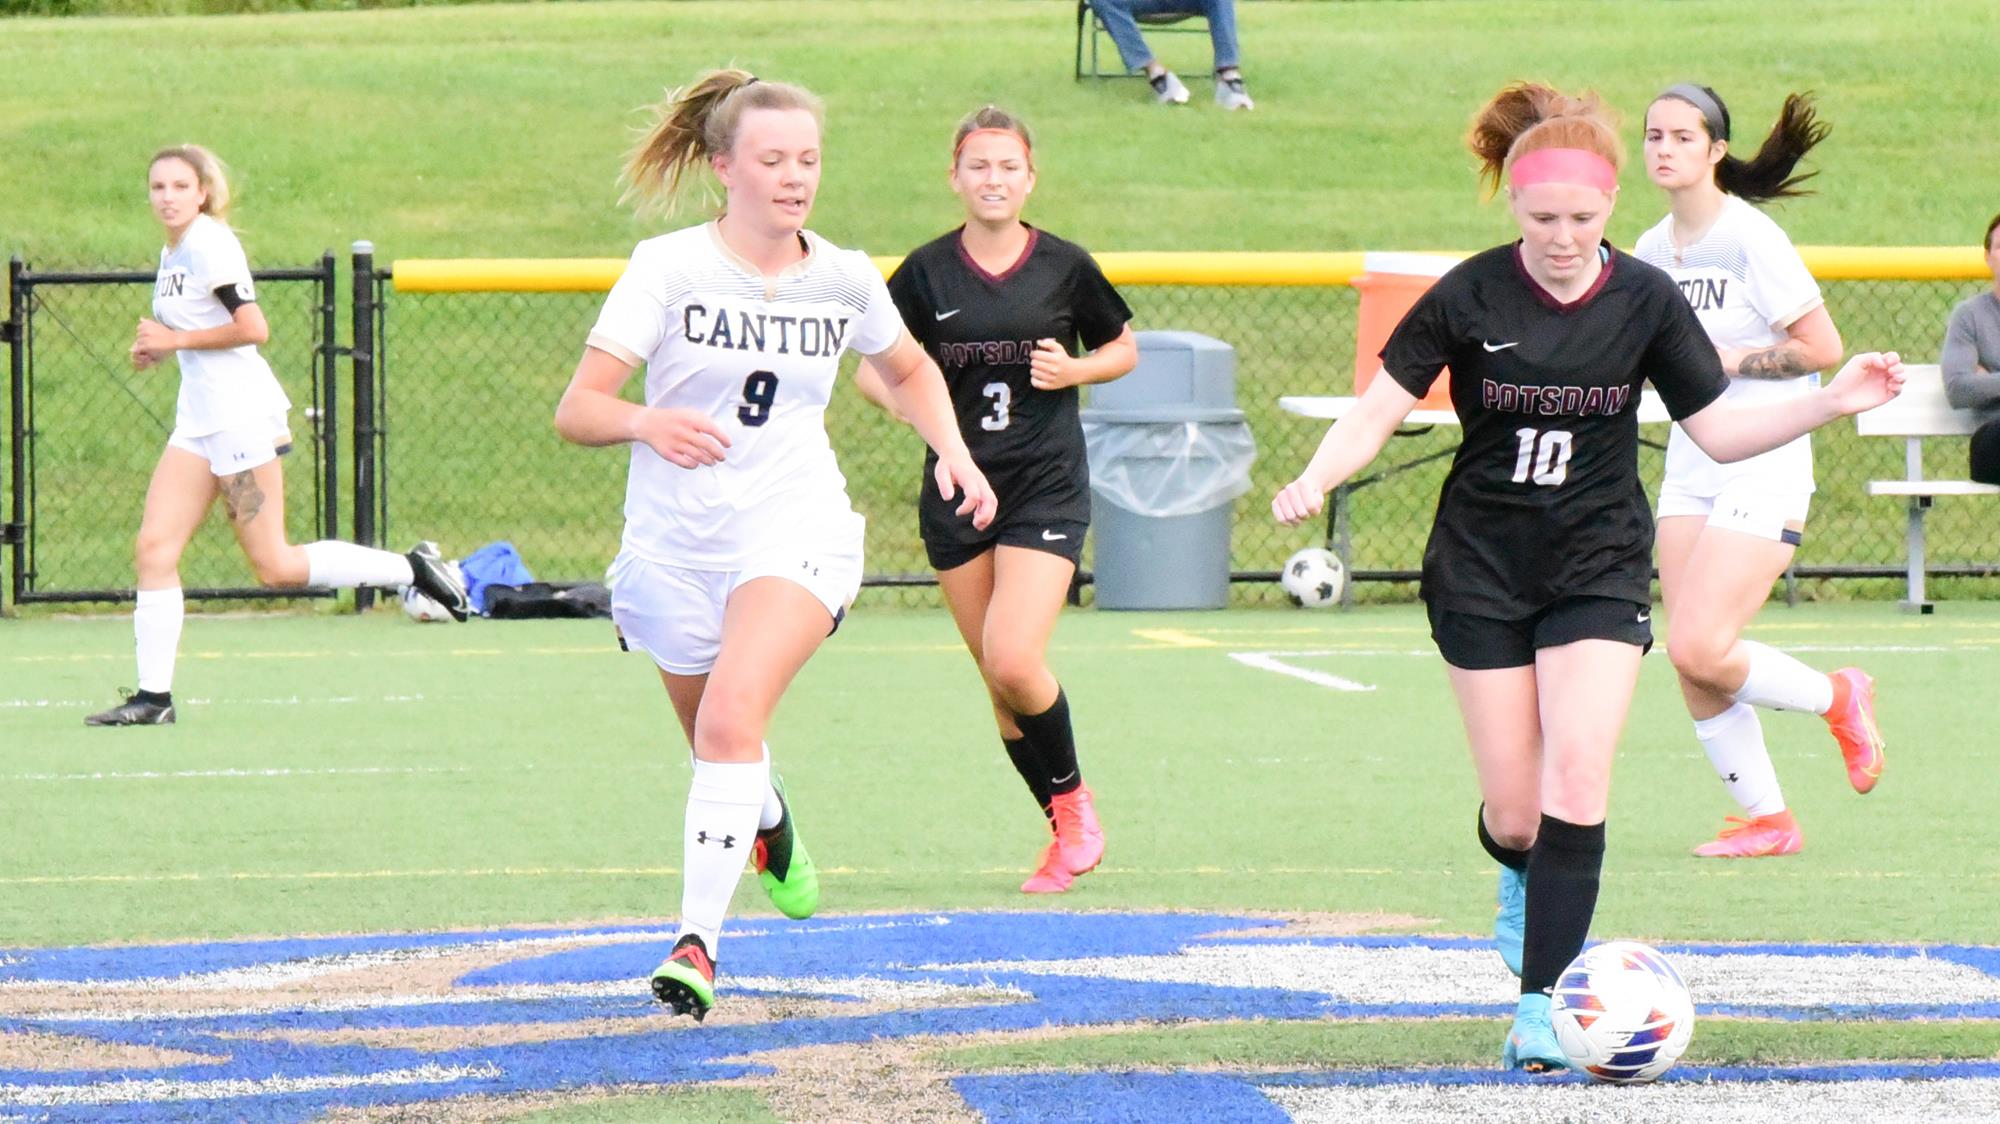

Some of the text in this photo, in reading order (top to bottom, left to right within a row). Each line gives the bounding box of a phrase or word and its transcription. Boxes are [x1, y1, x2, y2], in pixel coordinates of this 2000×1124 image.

[1678, 278, 1728, 311] TON
[684, 304, 849, 357] CANTON
[940, 340, 1035, 368] POTSDA
[737, 370, 779, 427] 9
[981, 382, 1011, 431] 3
[1482, 378, 1630, 416] POTSDAM
[1512, 427, 1573, 486] 10
